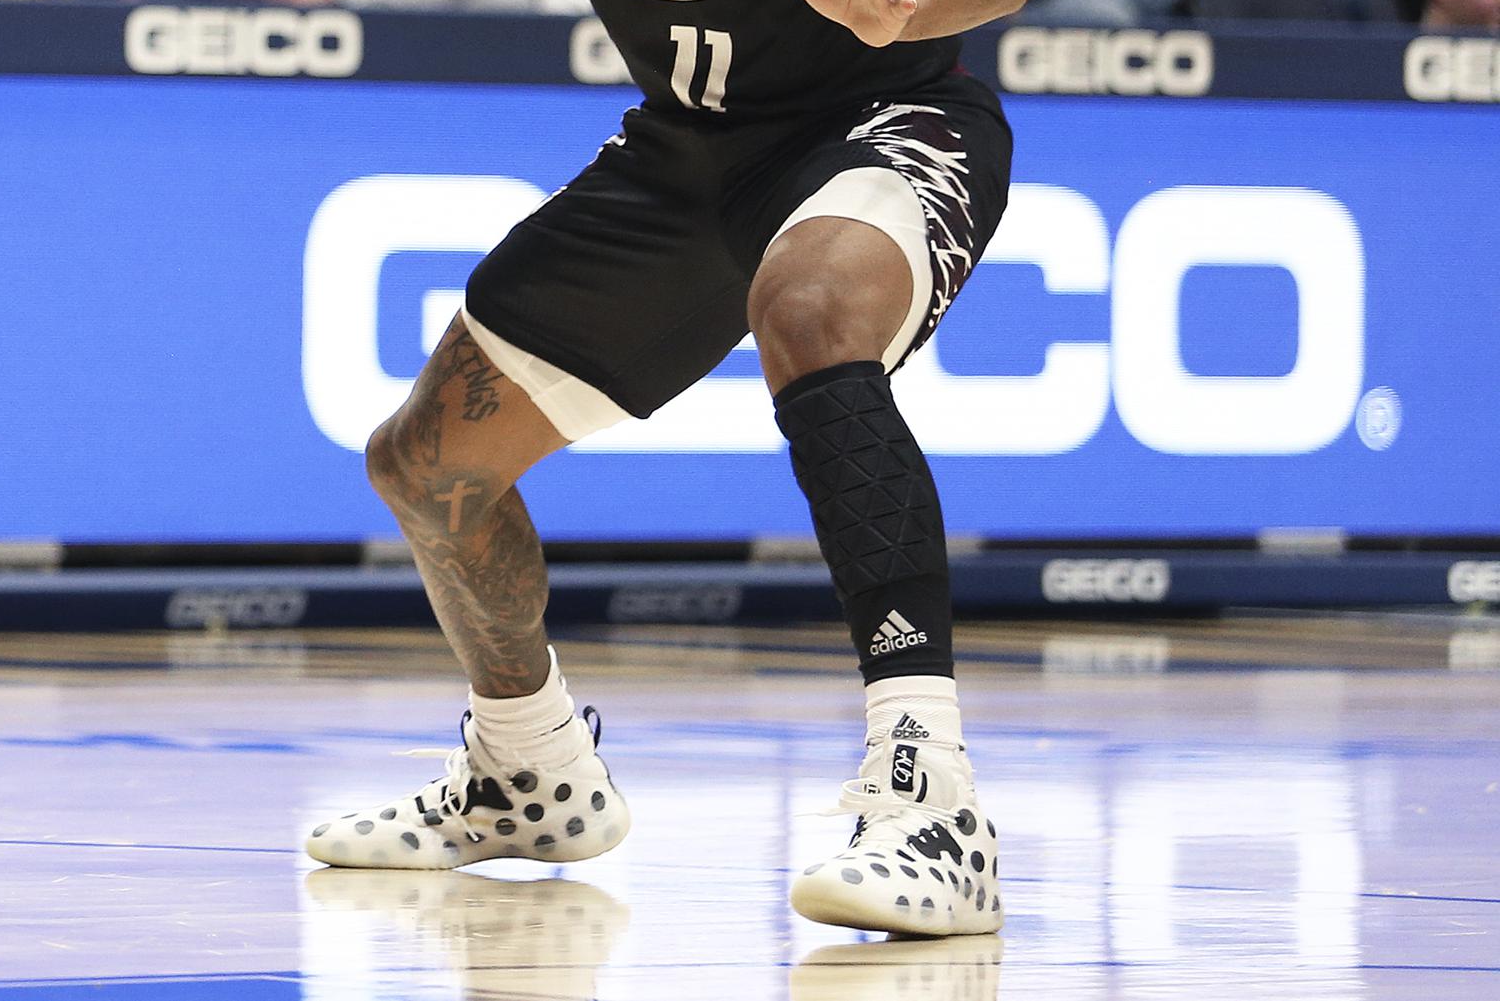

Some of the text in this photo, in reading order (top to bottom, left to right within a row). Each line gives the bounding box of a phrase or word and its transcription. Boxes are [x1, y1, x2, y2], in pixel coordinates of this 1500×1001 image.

[124, 5, 364, 78] GEICO
[669, 24, 734, 113] 11
[997, 26, 1214, 96] GEICO
[301, 172, 1366, 456] GCO
[1041, 557, 1171, 603] GEICO
[869, 631, 928, 657] adidas
